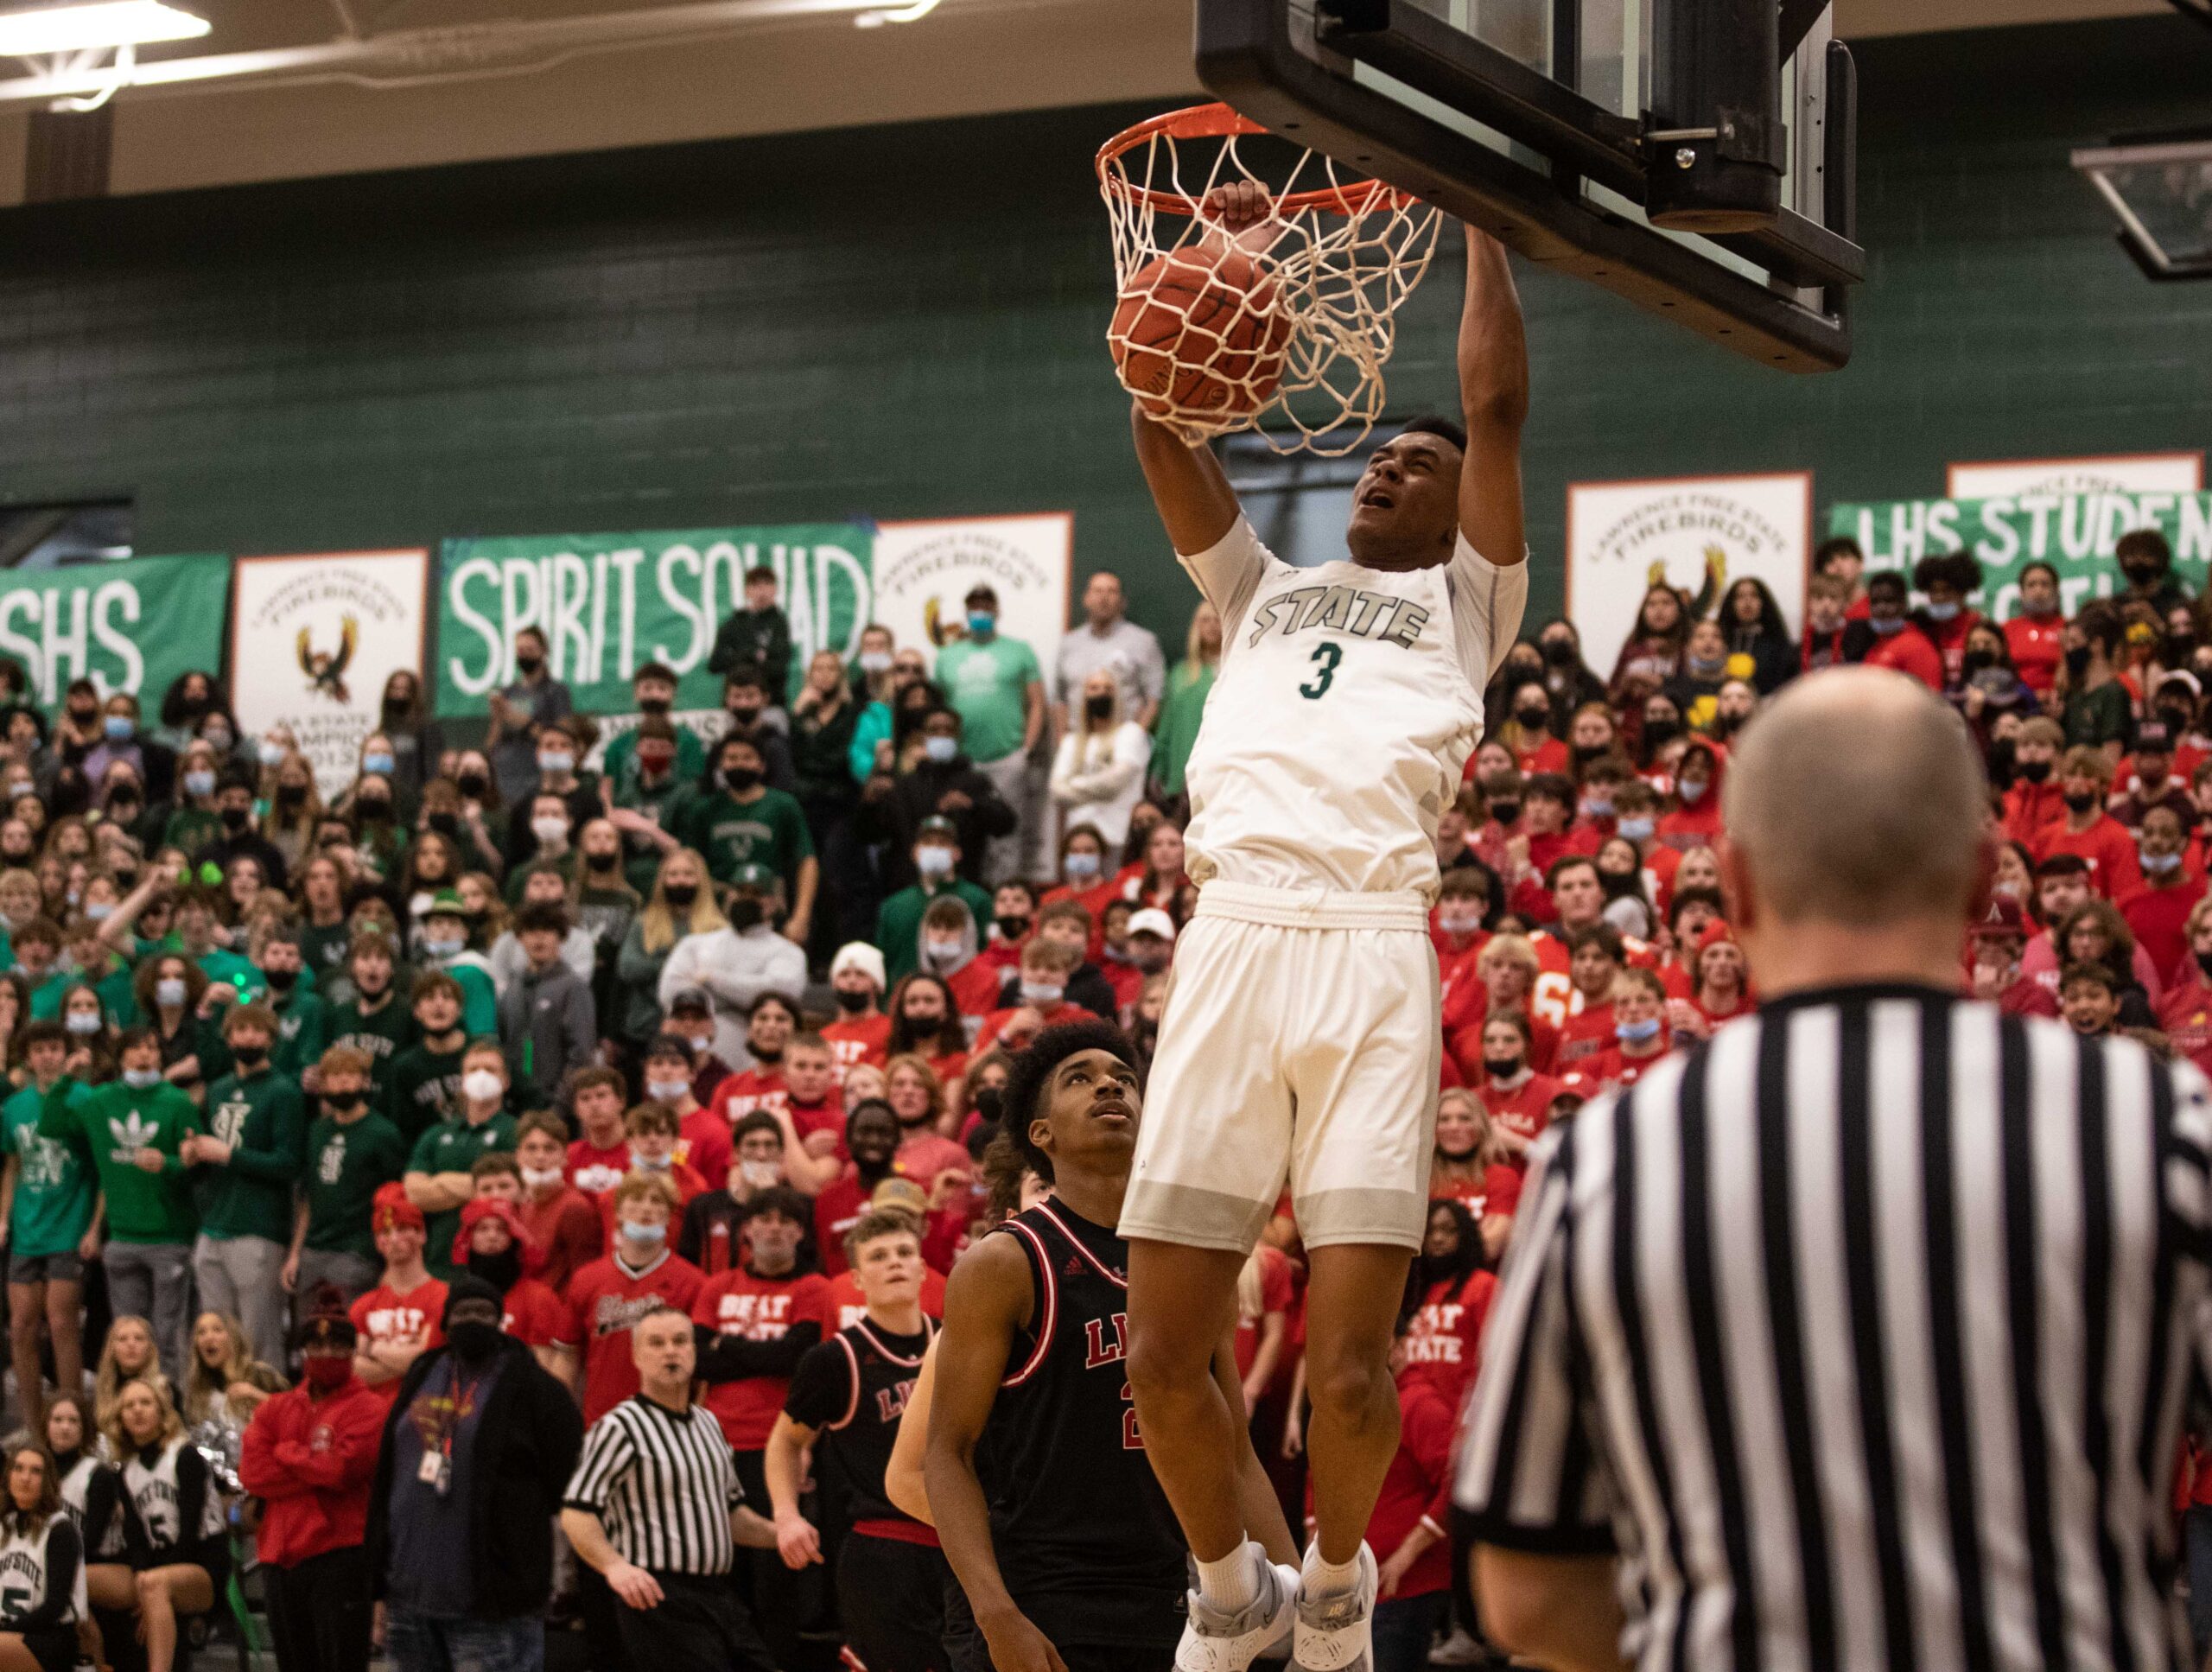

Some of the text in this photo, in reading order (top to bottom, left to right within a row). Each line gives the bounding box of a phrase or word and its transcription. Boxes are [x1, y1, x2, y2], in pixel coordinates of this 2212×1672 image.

[1688, 493, 1735, 513] FREE
[1613, 512, 1760, 558] FIREBIRDS
[1858, 501, 1963, 572] LHS
[895, 550, 1026, 595] FIREBIRDS
[448, 548, 645, 693] SPIRIT
[1249, 585, 1430, 649] STATE
[1299, 641, 1343, 700] 3
[1404, 1335, 1464, 1365] TATE
